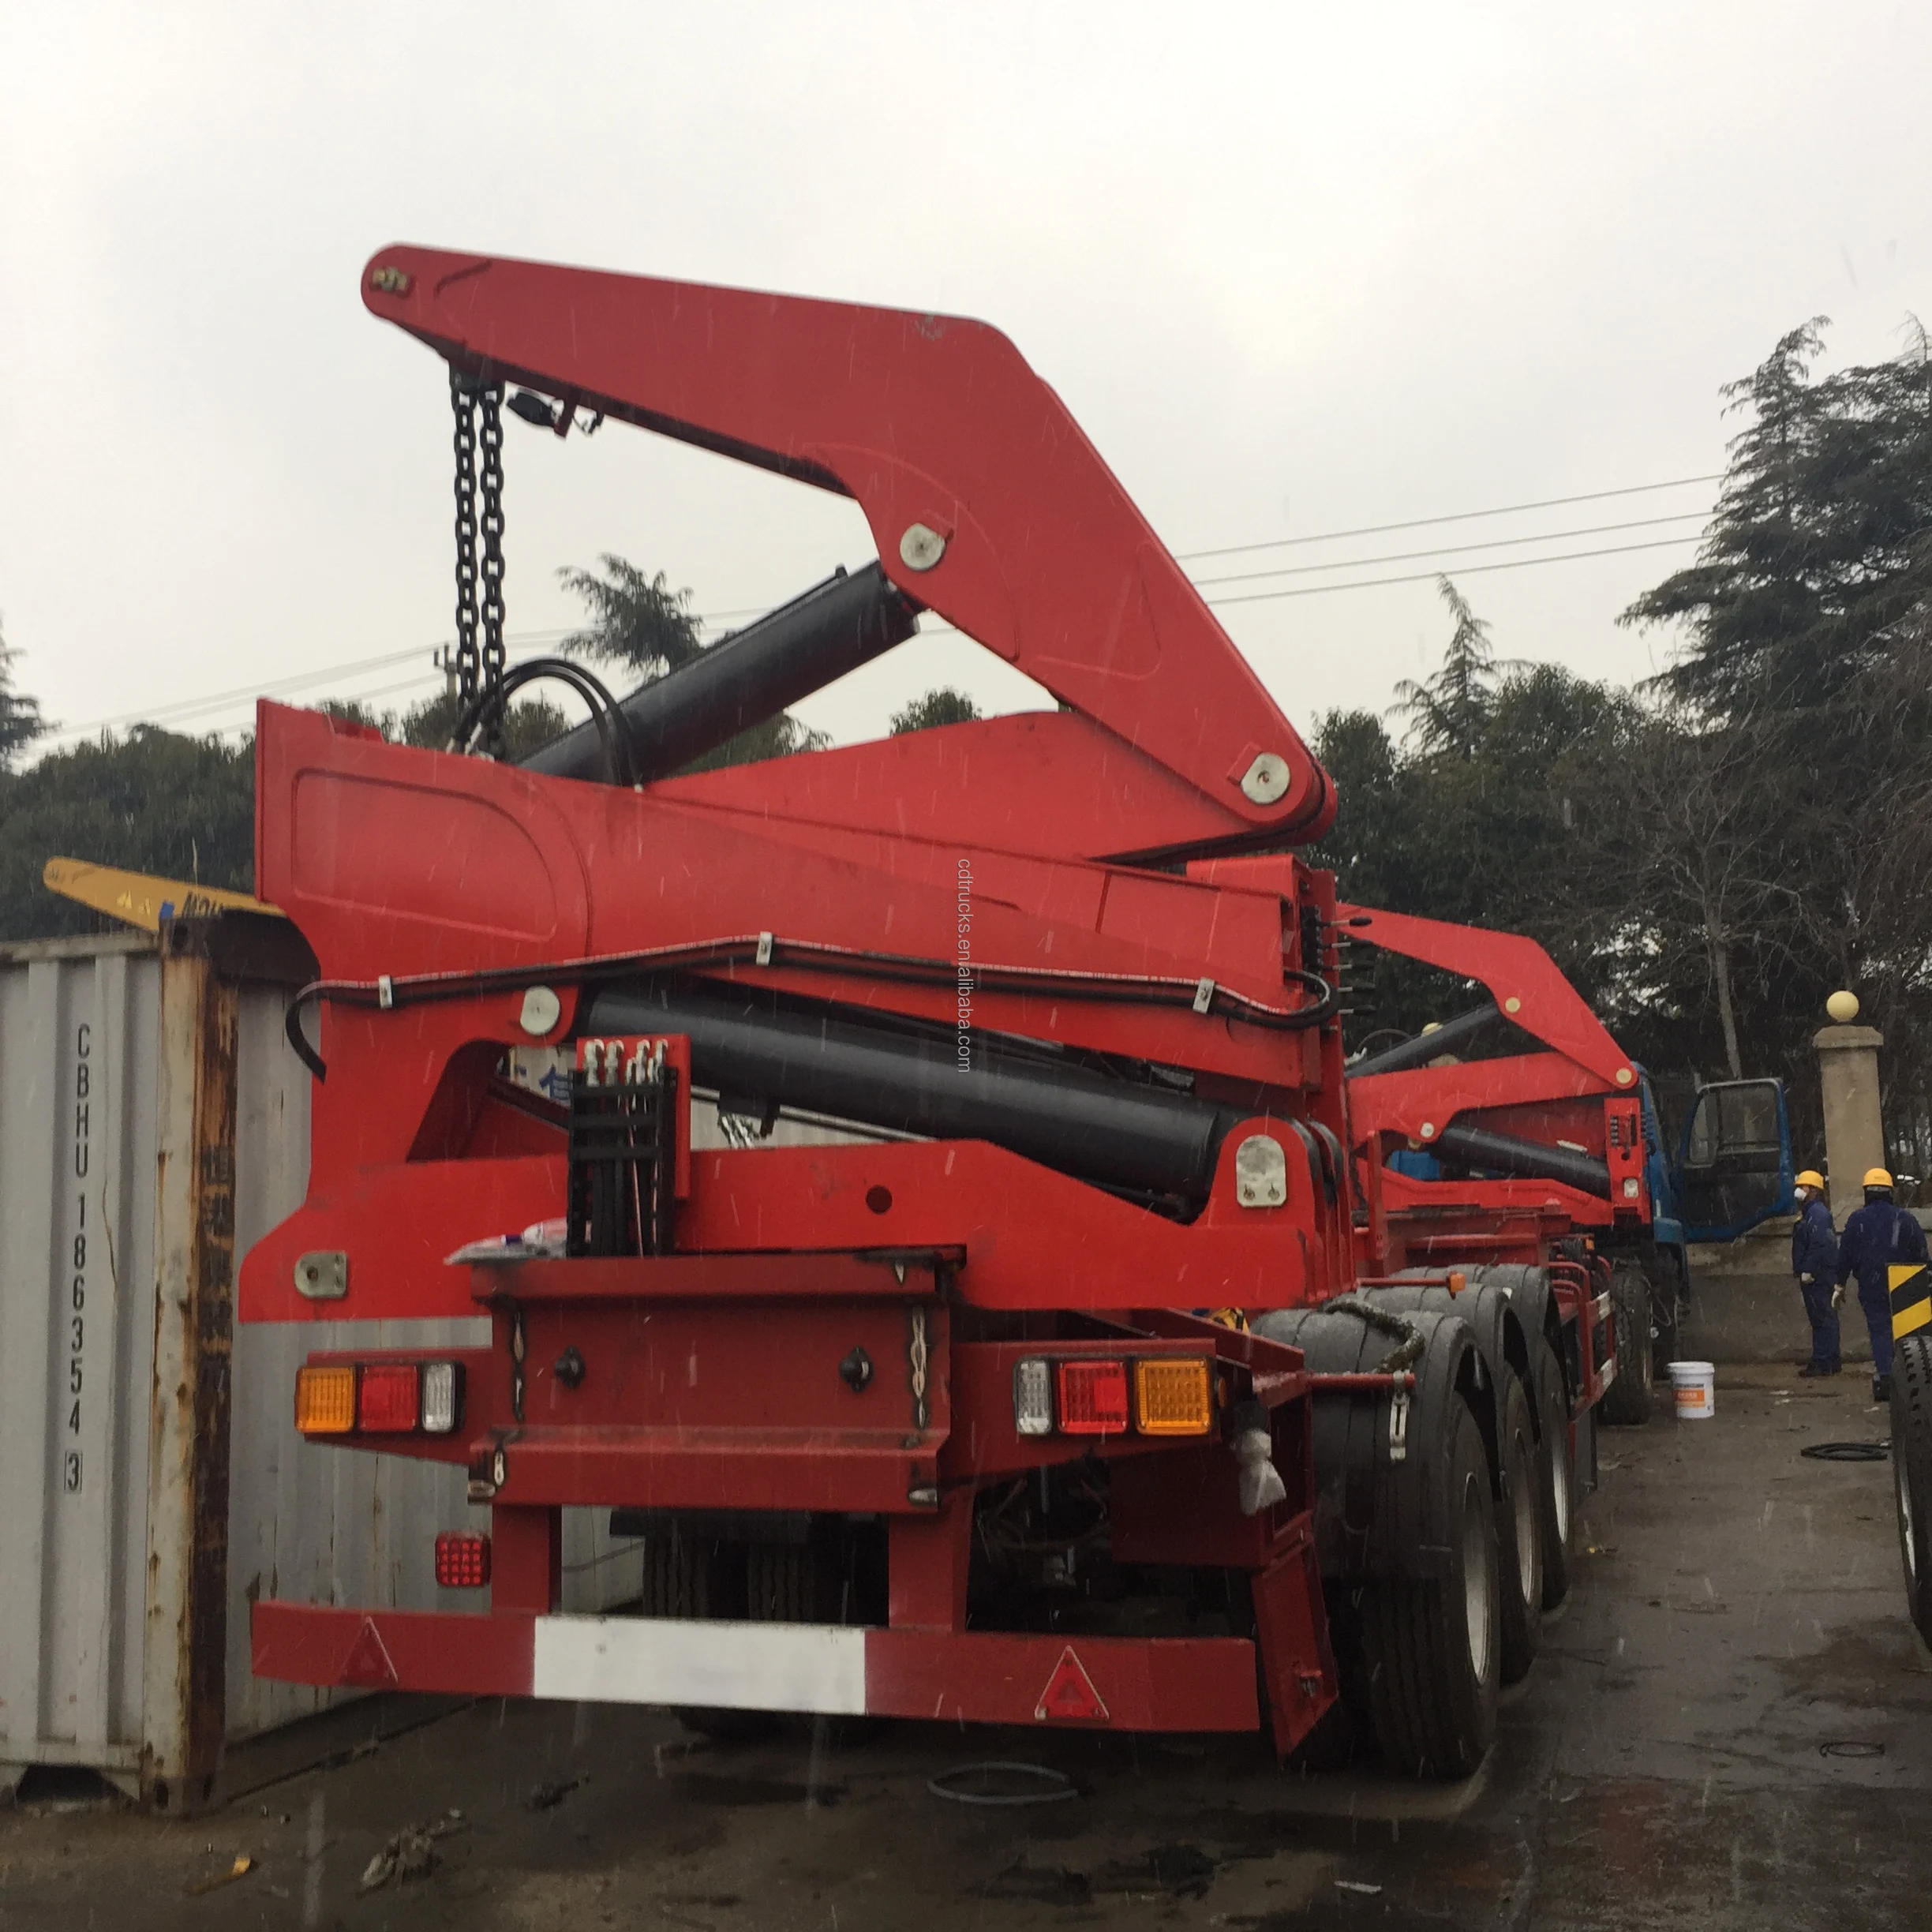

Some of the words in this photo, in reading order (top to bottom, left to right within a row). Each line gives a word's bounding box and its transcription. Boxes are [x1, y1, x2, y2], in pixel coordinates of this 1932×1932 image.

[76, 1023, 91, 1178] CBHU
[69, 1192, 86, 1436] 186354
[66, 1451, 80, 1492] 3
